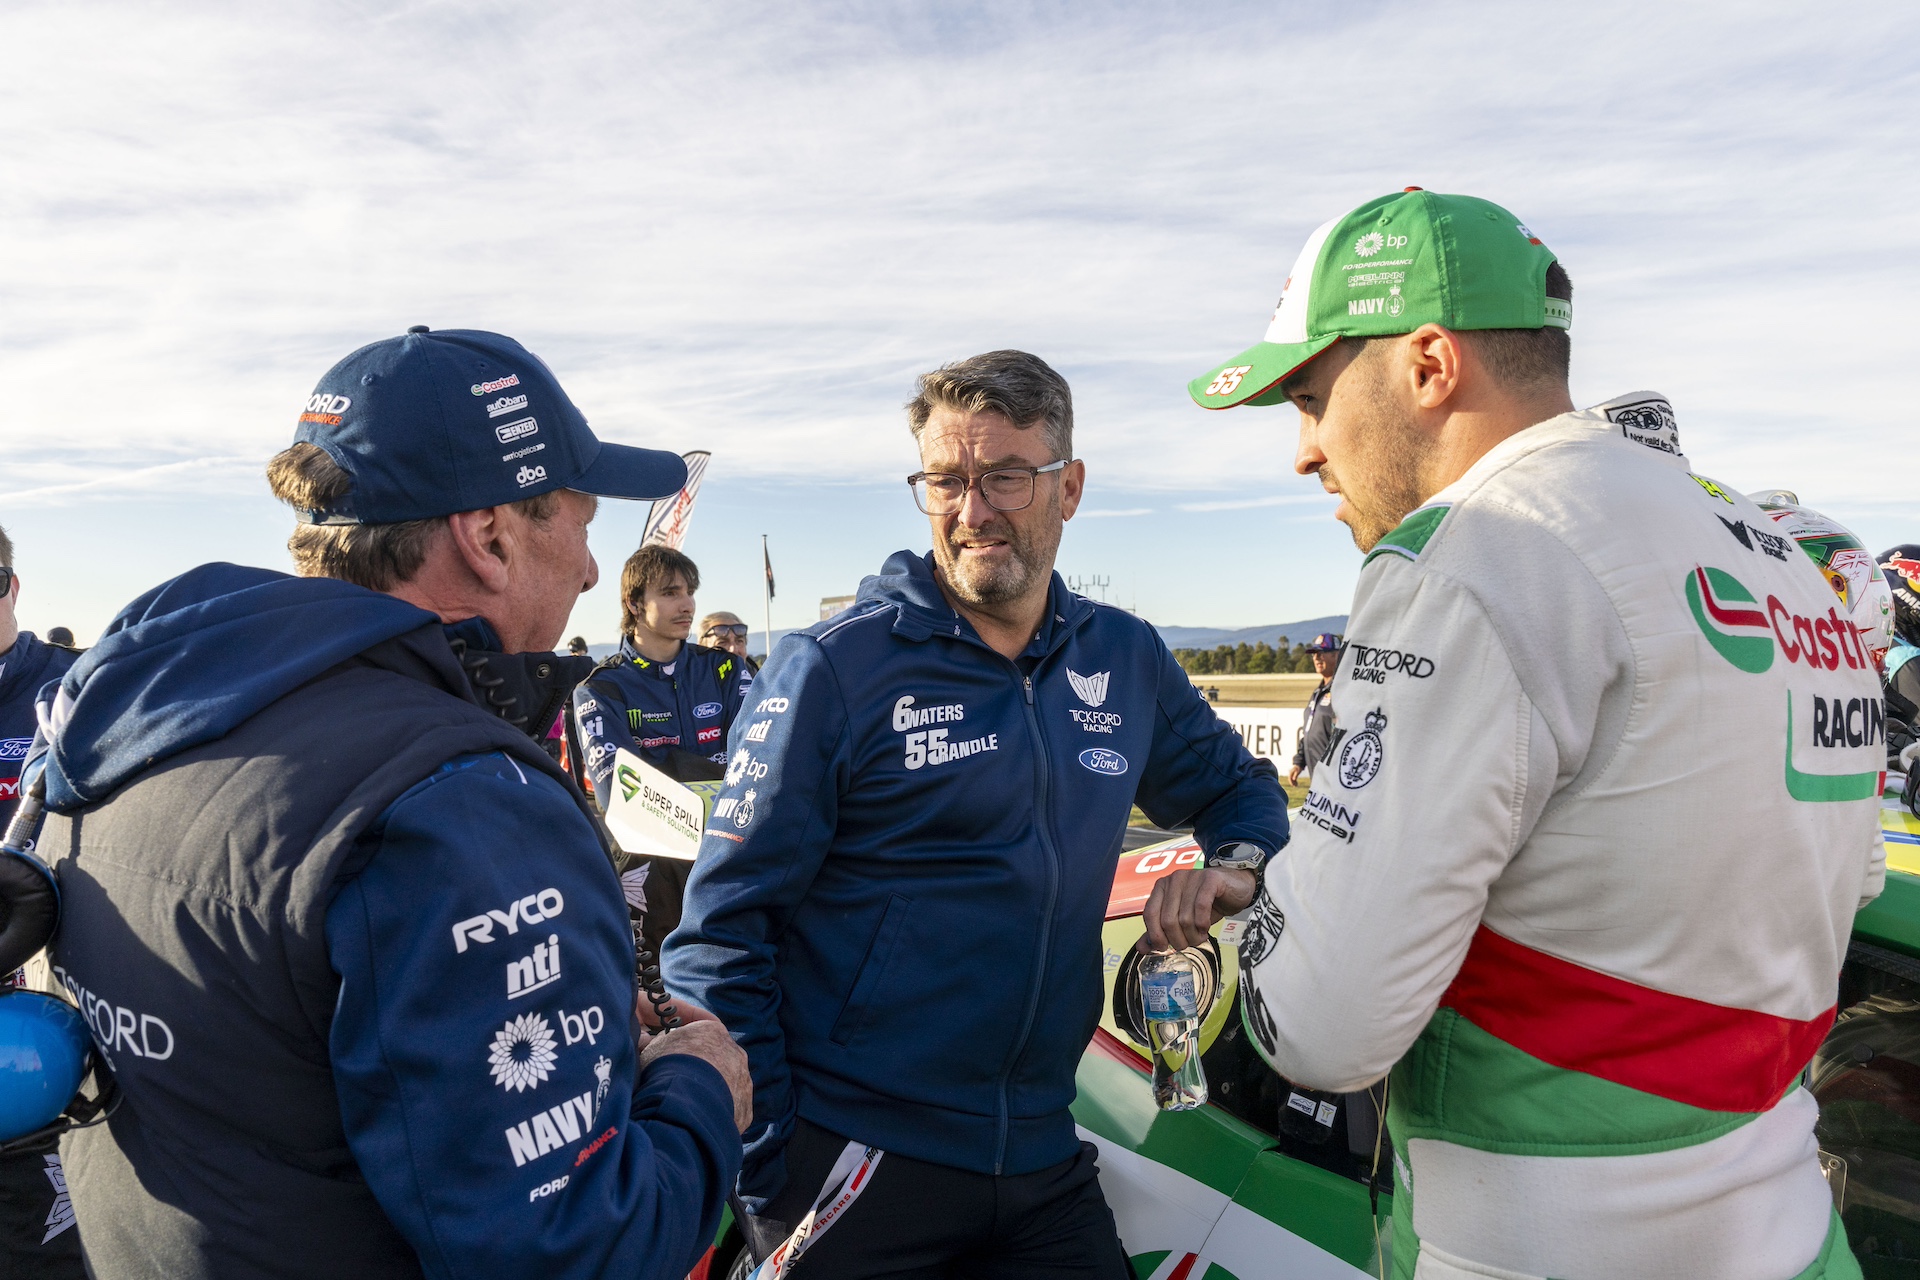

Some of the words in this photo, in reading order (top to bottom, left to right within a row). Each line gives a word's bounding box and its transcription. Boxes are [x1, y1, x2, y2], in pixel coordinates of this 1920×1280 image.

[1386, 233, 1408, 250] bp
[1341, 258, 1414, 271] FORDPERFORMANCE
[1347, 278, 1405, 288] electrical
[1347, 297, 1385, 316] NAVY
[482, 374, 519, 393] Castrol
[1204, 364, 1254, 397] 55
[511, 420, 535, 437] ENZED
[1629, 432, 1643, 445] Not
[516, 465, 547, 484] dba
[1766, 594, 1870, 673] Castr
[1351, 643, 1436, 679] TICKFORD
[1351, 668, 1386, 685] RACING
[642, 711, 673, 720] MONSTER
[696, 705, 718, 717] Ford
[905, 703, 965, 729] WATERS
[1069, 709, 1122, 727] TICKFORD
[748, 718, 773, 739] nti
[1084, 724, 1113, 734] RACING
[0, 740, 32, 757] For
[642, 735, 680, 748] Castrol
[904, 727, 949, 771] 55
[938, 732, 999, 765] RANDLE
[1241, 724, 1282, 756] VER
[1090, 750, 1120, 772] Ford
[1341, 745, 1353, 766] ROYAL
[1352, 734, 1381, 754] AUSTRALIAN
[1367, 756, 1381, 778] NAVY
[747, 757, 769, 782] bp
[643, 785, 673, 814] SUPER
[674, 805, 700, 832] SPILL
[641, 800, 646, 808] &
[646, 803, 667, 822] SAFETY
[667, 816, 699, 843] SOLUTIONS
[452, 887, 564, 954] RYCO
[507, 933, 561, 994] nti
[558, 1005, 605, 1046] bp
[505, 1090, 592, 1168] NAVY
[529, 1174, 570, 1203] FORD
